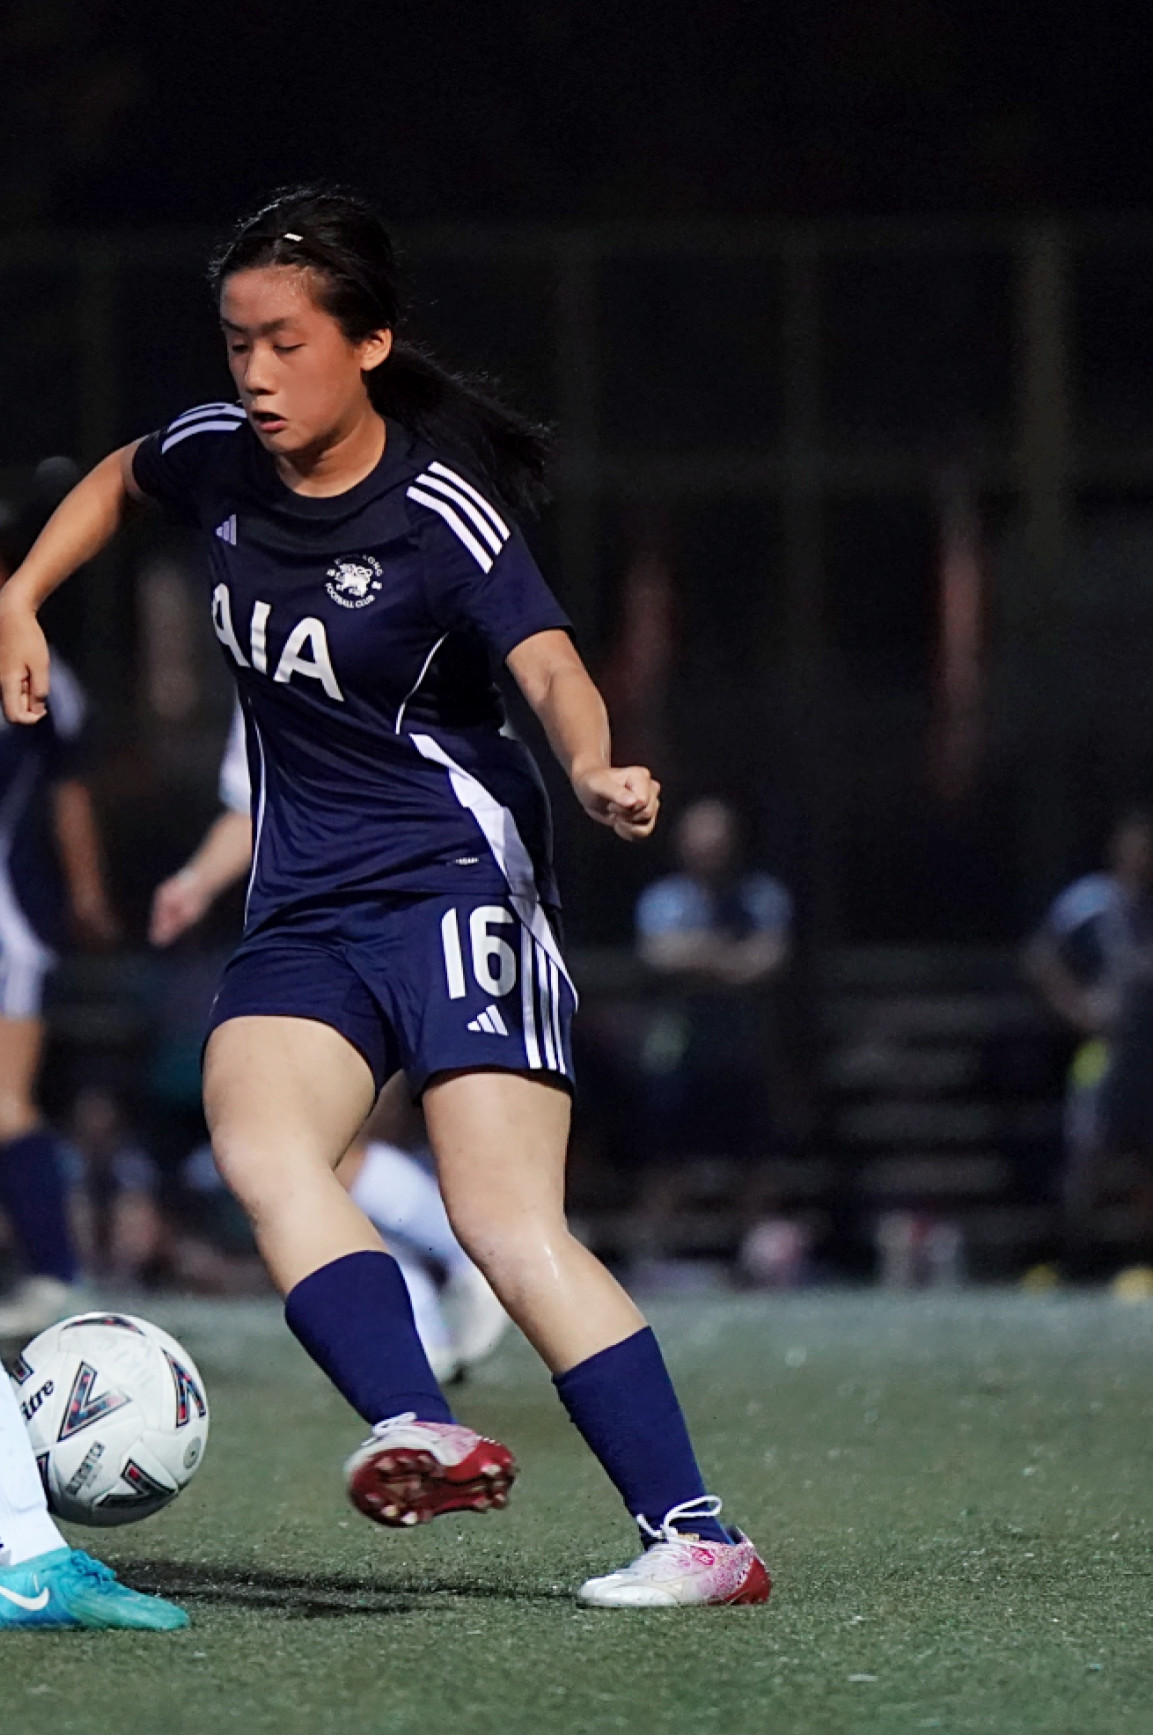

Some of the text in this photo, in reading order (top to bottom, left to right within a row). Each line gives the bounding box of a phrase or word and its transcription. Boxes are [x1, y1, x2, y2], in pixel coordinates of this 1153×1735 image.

[212, 582, 344, 702] AIA
[441, 904, 516, 1000] 16
[21, 1379, 55, 1421] itre
